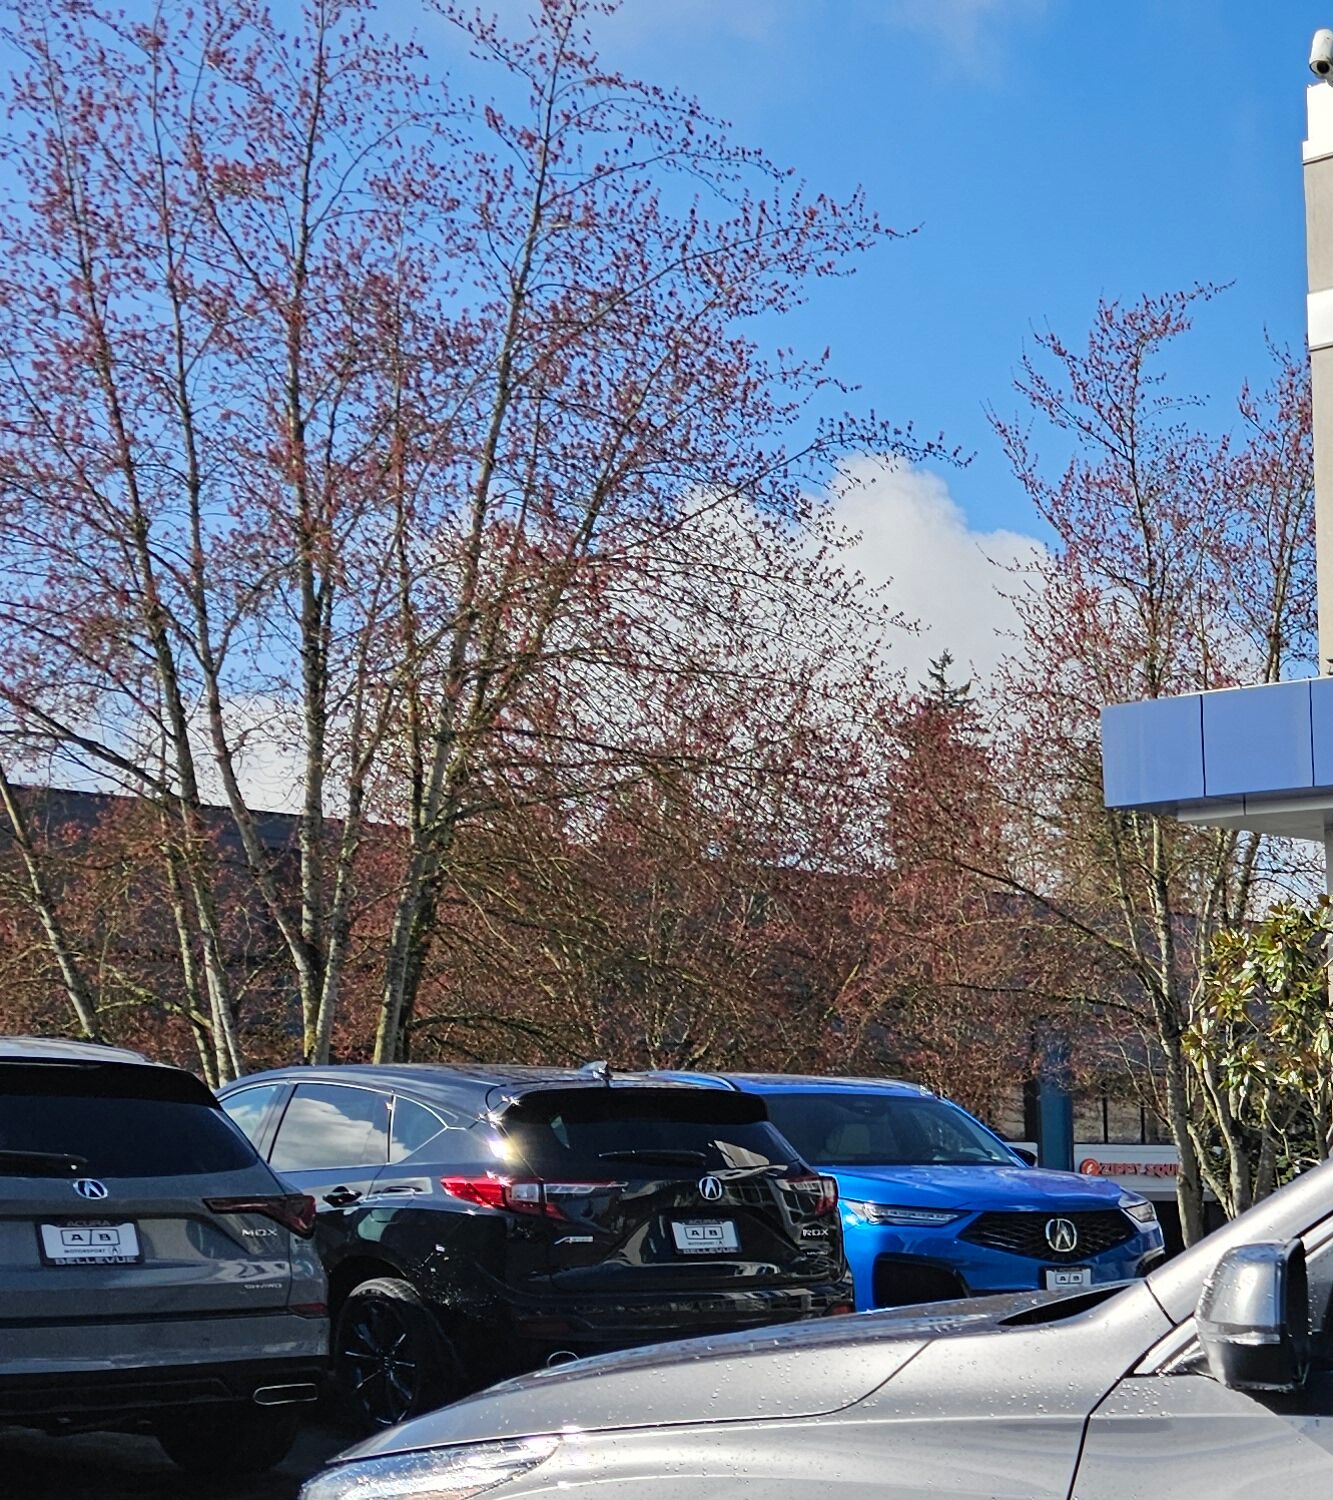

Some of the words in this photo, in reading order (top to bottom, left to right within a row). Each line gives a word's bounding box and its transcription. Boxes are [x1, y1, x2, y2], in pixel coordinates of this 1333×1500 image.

[241, 1228, 278, 1237] MDX
[802, 1228, 829, 1237] RDX
[71, 1233, 84, 1242] A
[54, 1256, 137, 1265] BELLEVUE
